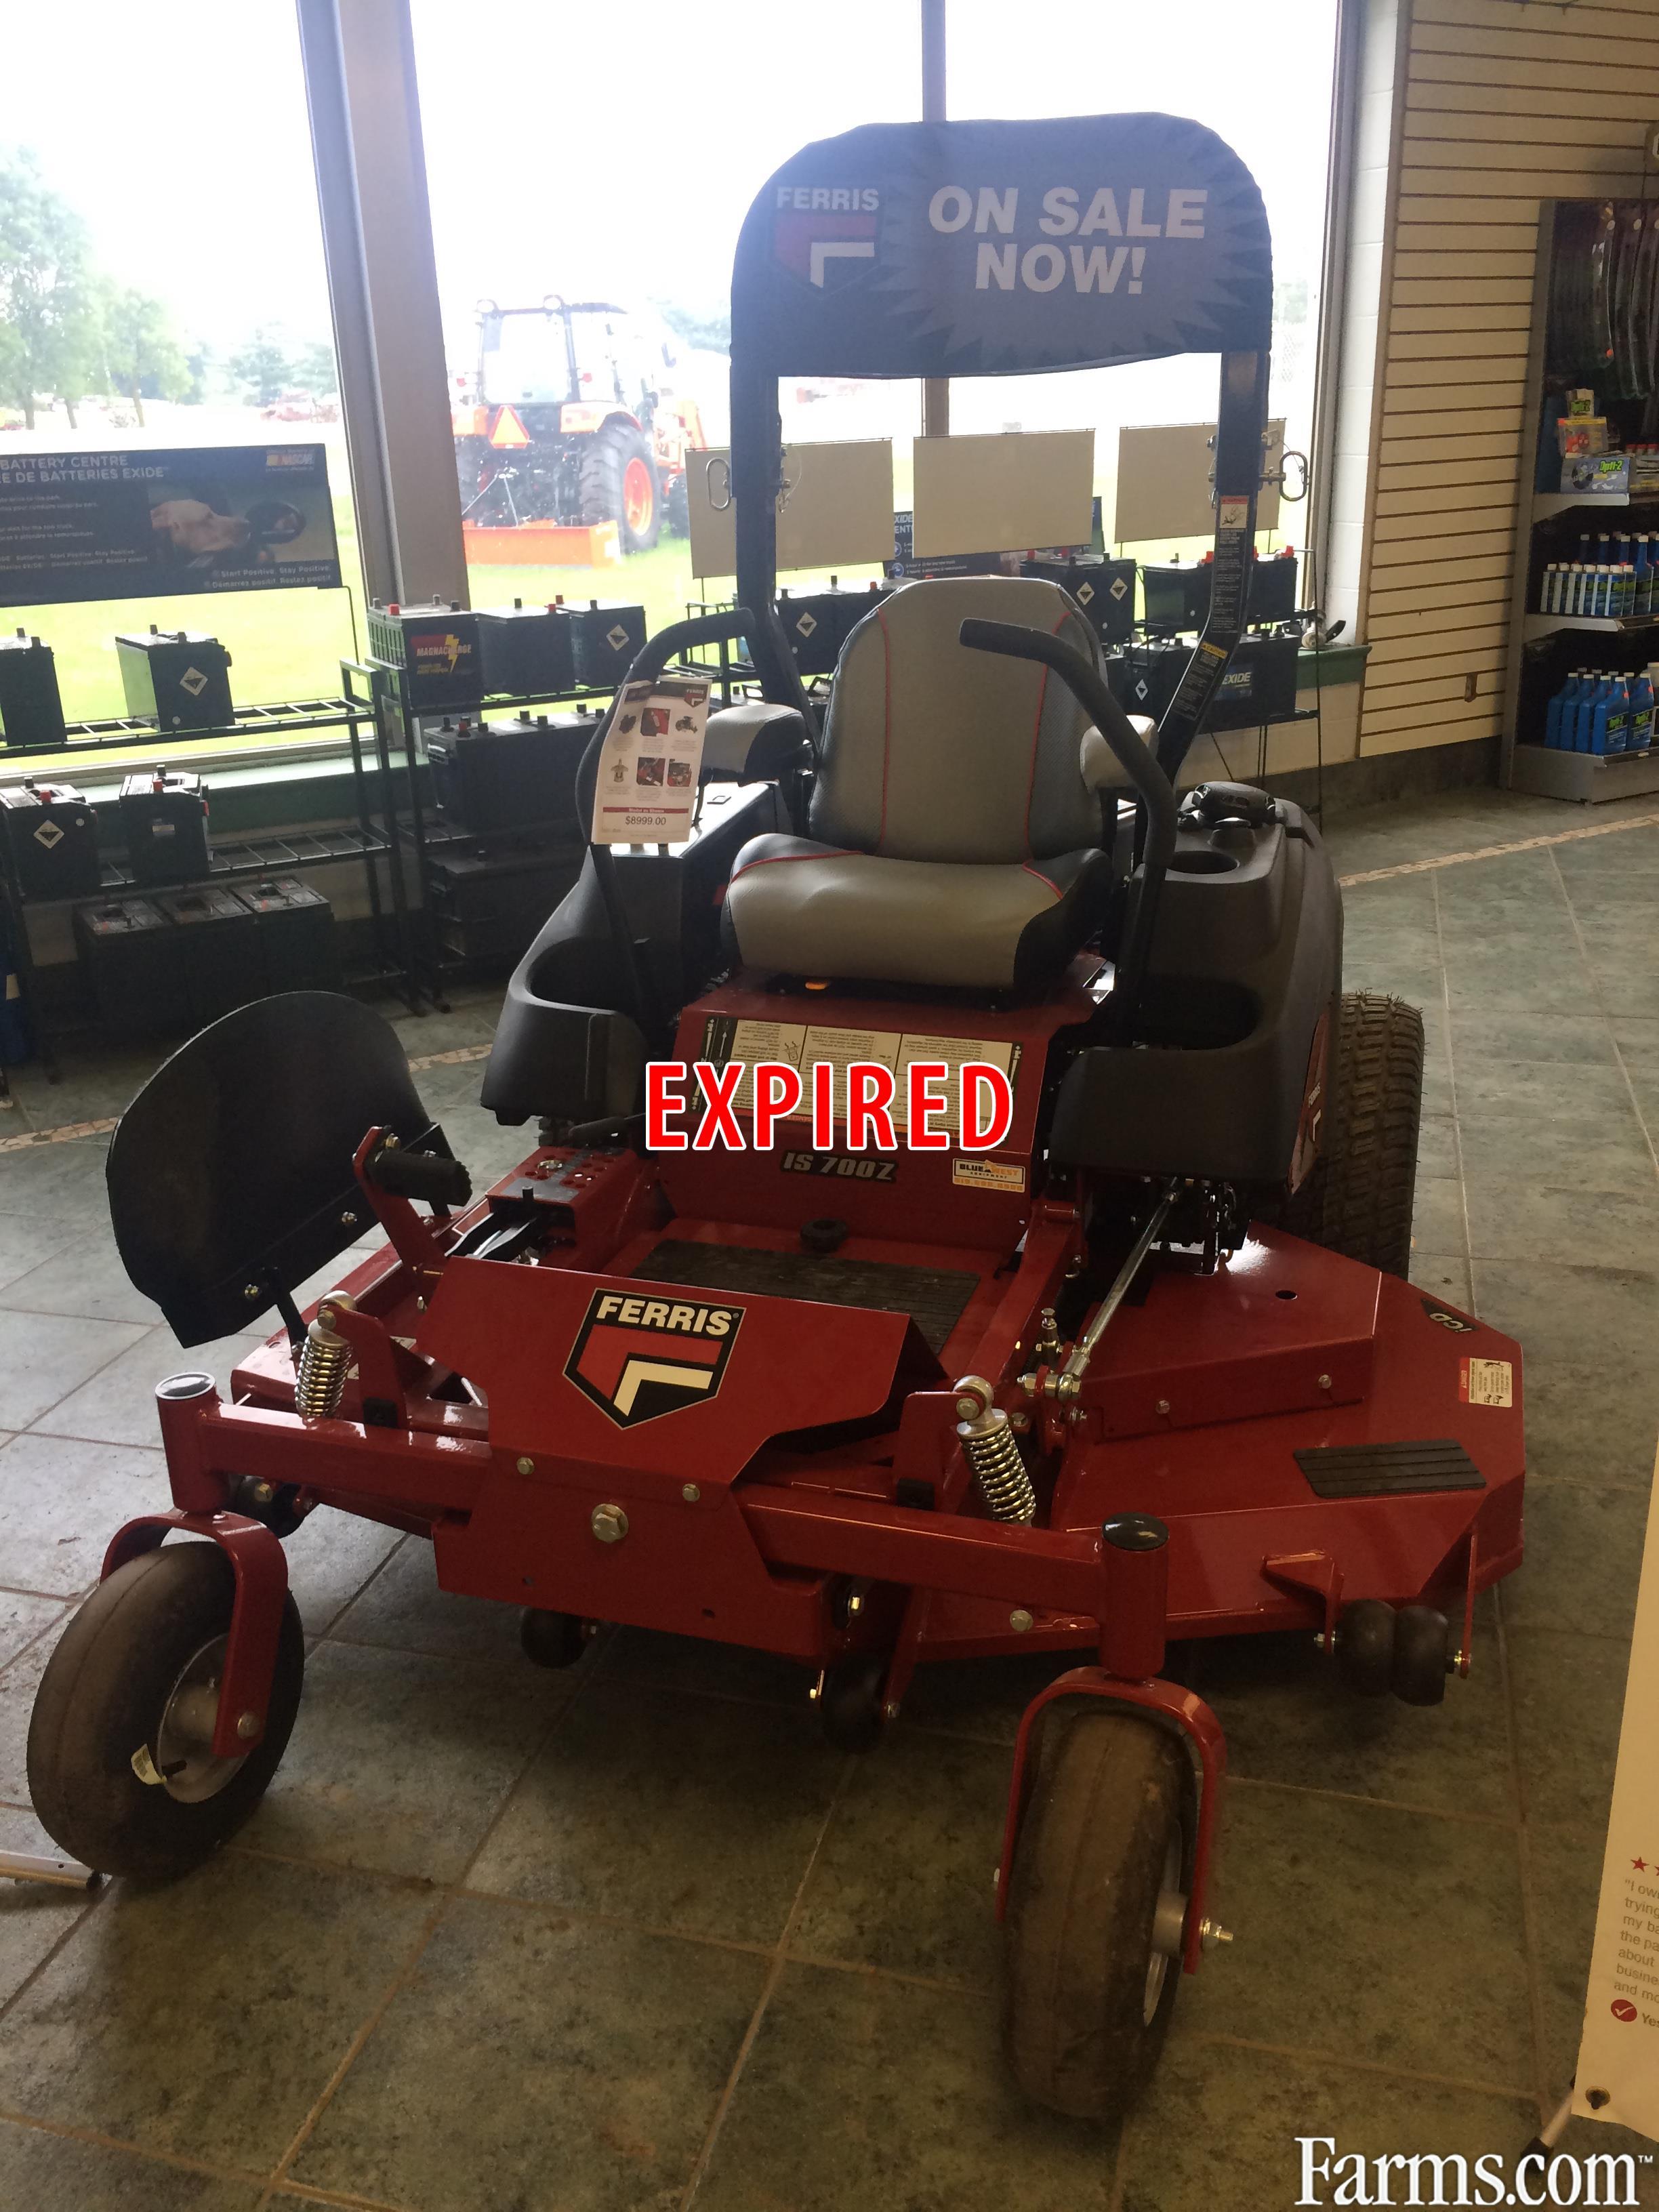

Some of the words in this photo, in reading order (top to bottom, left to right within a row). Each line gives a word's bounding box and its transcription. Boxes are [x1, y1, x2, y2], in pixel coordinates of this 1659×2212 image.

[777, 187, 880, 211] FERRIS
[928, 185, 1019, 234] ON
[1038, 186, 1208, 239] SALE
[975, 243, 1146, 294] NOW!
[0, 457, 66, 470] BATTERY
[70, 455, 128, 468] CENTRE
[16, 471, 36, 483] DE
[41, 468, 119, 483] BATTERIES
[122, 466, 164, 479] EXIDE
[895, 514, 913, 523] XIDE
[1222, 672, 1252, 685] EXIDE
[625, 816, 666, 826] $8999.00
[783, 1152, 814, 1171] IS
[821, 1156, 895, 1181] 700Z
[959, 1164, 983, 1172] BLUE
[596, 1295, 732, 1336] FERRIS
[1638, 1885, 1659, 1900] ow
[1623, 1915, 1643, 1930] my
[1620, 1930, 1641, 1945] the
[1618, 1948, 1655, 1967] about
[1614, 1980, 1638, 1996] and
